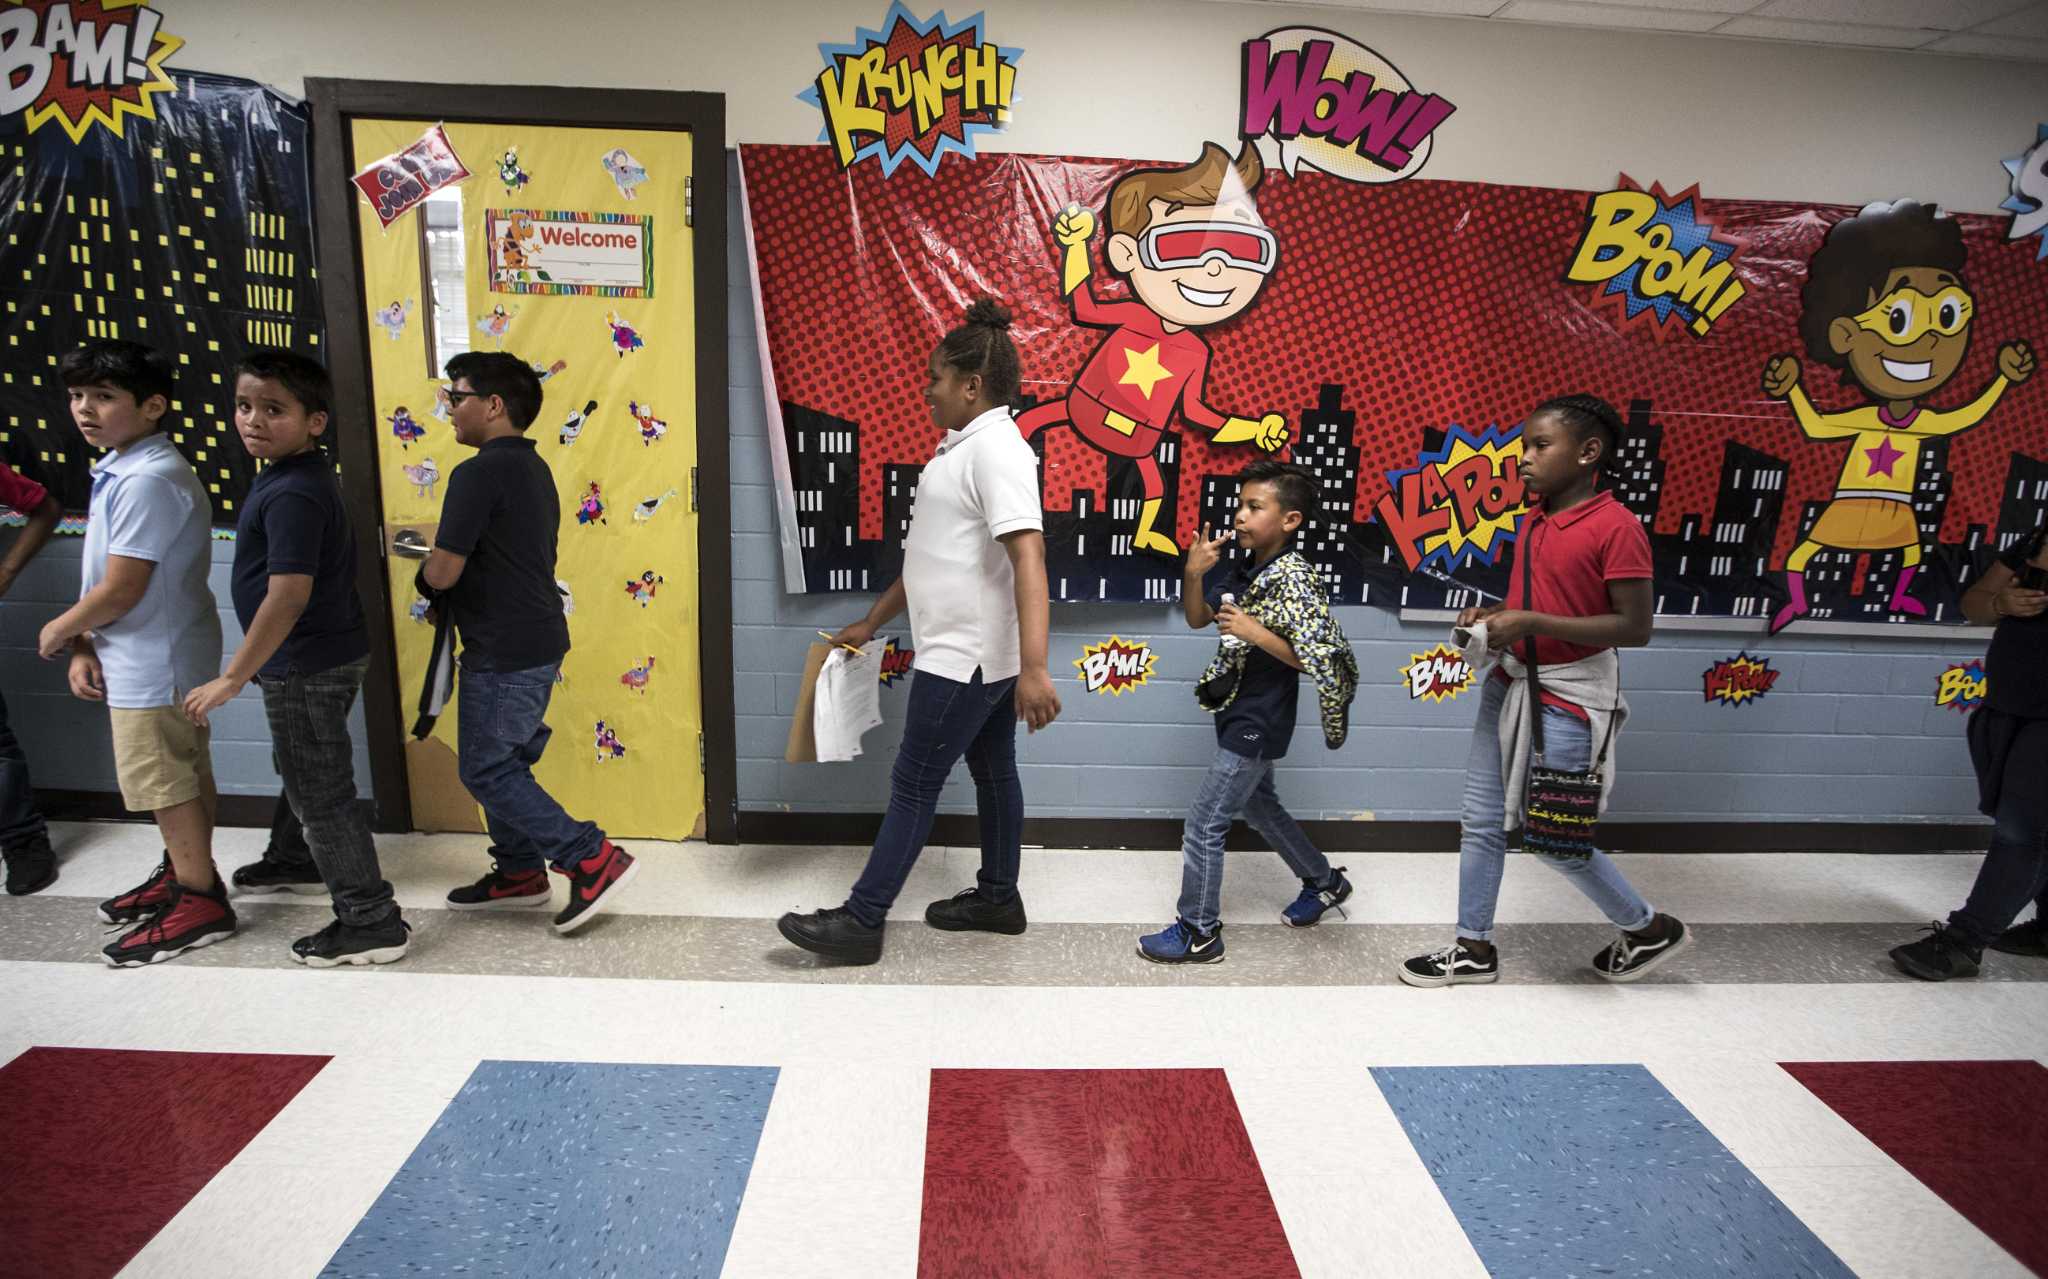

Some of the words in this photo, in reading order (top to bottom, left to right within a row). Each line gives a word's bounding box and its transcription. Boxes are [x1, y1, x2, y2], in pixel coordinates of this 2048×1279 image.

[0, 3, 161, 116] BAM!
[818, 43, 1016, 170] KRUNCH!
[1241, 39, 1457, 171] WOW!
[540, 226, 637, 249] Welcome
[1565, 190, 1747, 337] BOOM!
[1376, 454, 1538, 573] KAPOW
[1082, 647, 1151, 691] BAM!
[1408, 657, 1470, 698] BAM!
